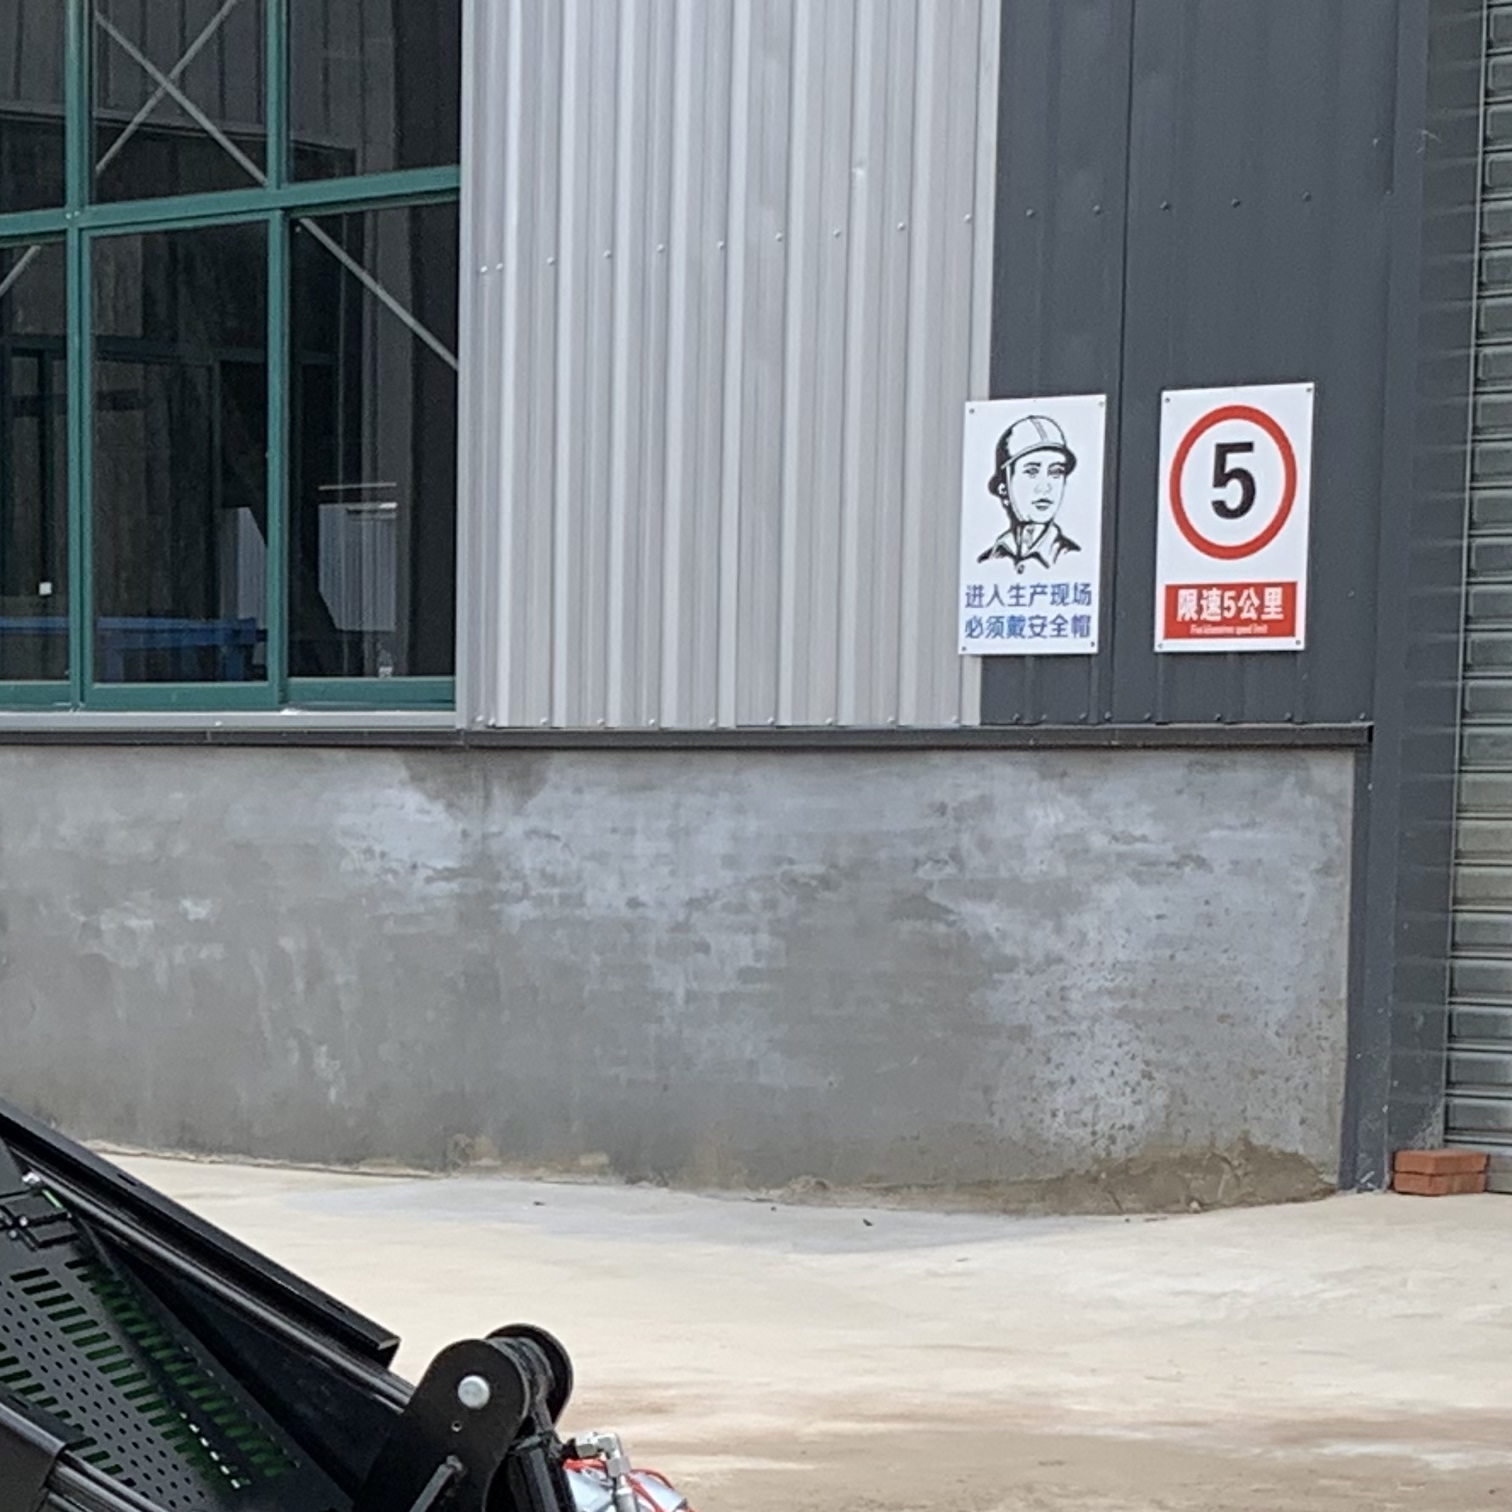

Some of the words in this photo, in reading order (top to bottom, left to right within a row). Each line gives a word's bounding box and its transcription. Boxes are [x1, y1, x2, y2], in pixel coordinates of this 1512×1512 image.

[1211, 441, 1256, 520] 5
[965, 582, 1092, 608] 进入生产现场
[1176, 587, 1284, 622] 限速5公里
[965, 613, 1091, 639] 必须戴安全帽
